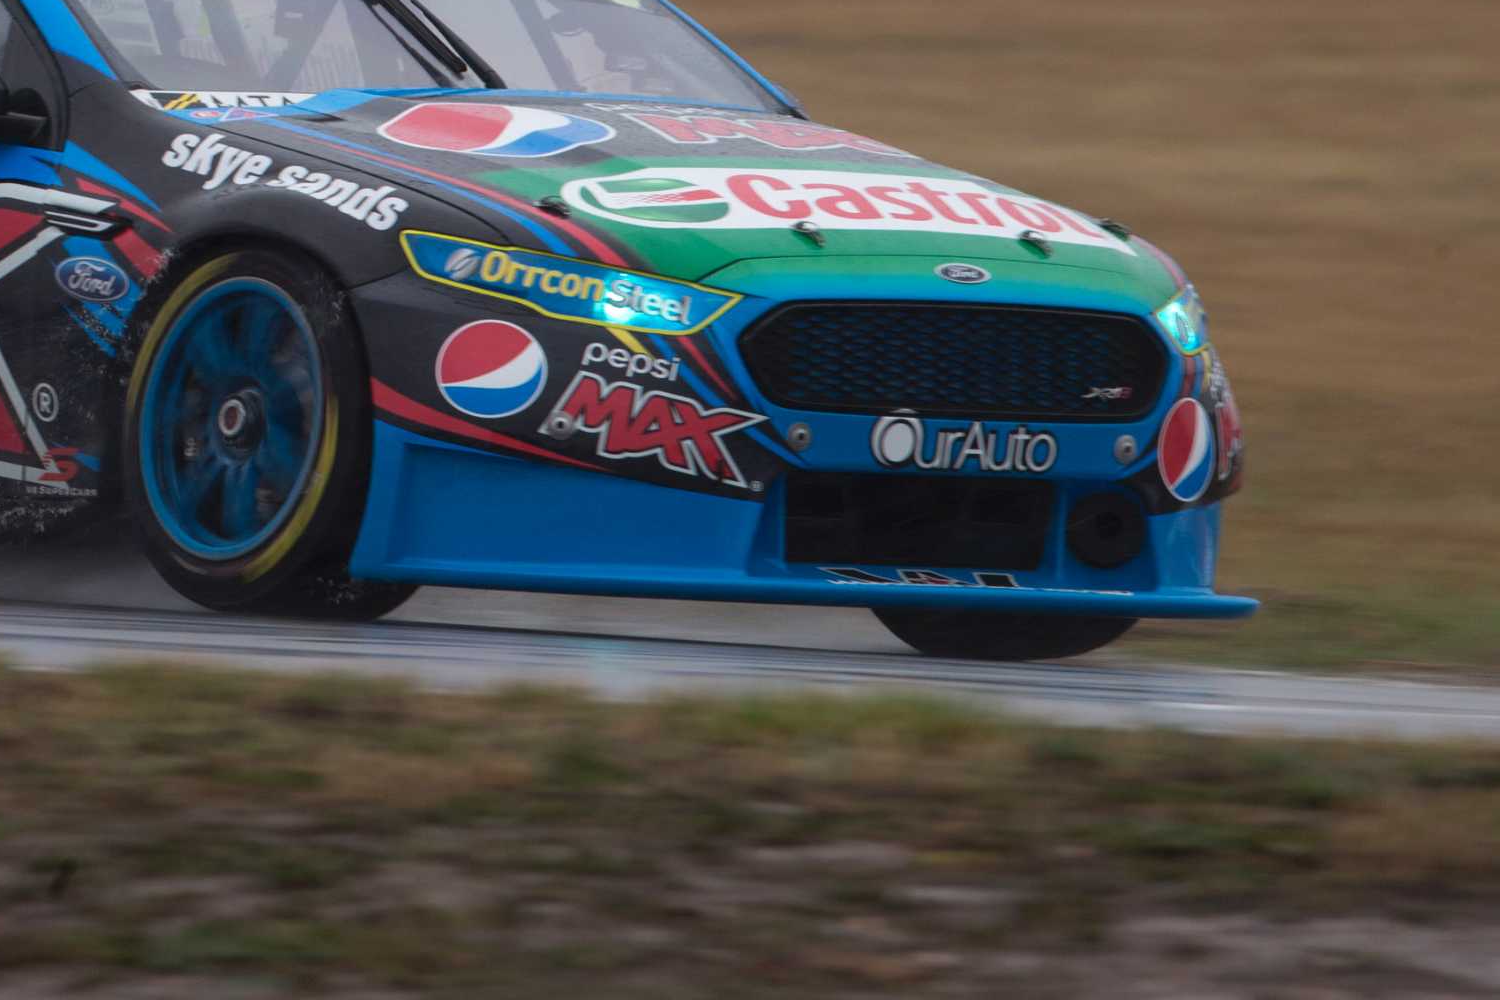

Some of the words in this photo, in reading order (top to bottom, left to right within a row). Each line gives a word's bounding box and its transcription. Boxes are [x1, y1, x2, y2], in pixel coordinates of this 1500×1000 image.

[161, 132, 274, 191] skye
[265, 164, 410, 232] sands
[725, 173, 1105, 240] Castrol
[67, 260, 118, 297] Ford
[479, 250, 604, 301] Orrcon
[609, 278, 692, 326] Steel
[581, 341, 682, 382] pepsi
[536, 369, 771, 489] MAX
[871, 407, 1058, 473] OurAuto
